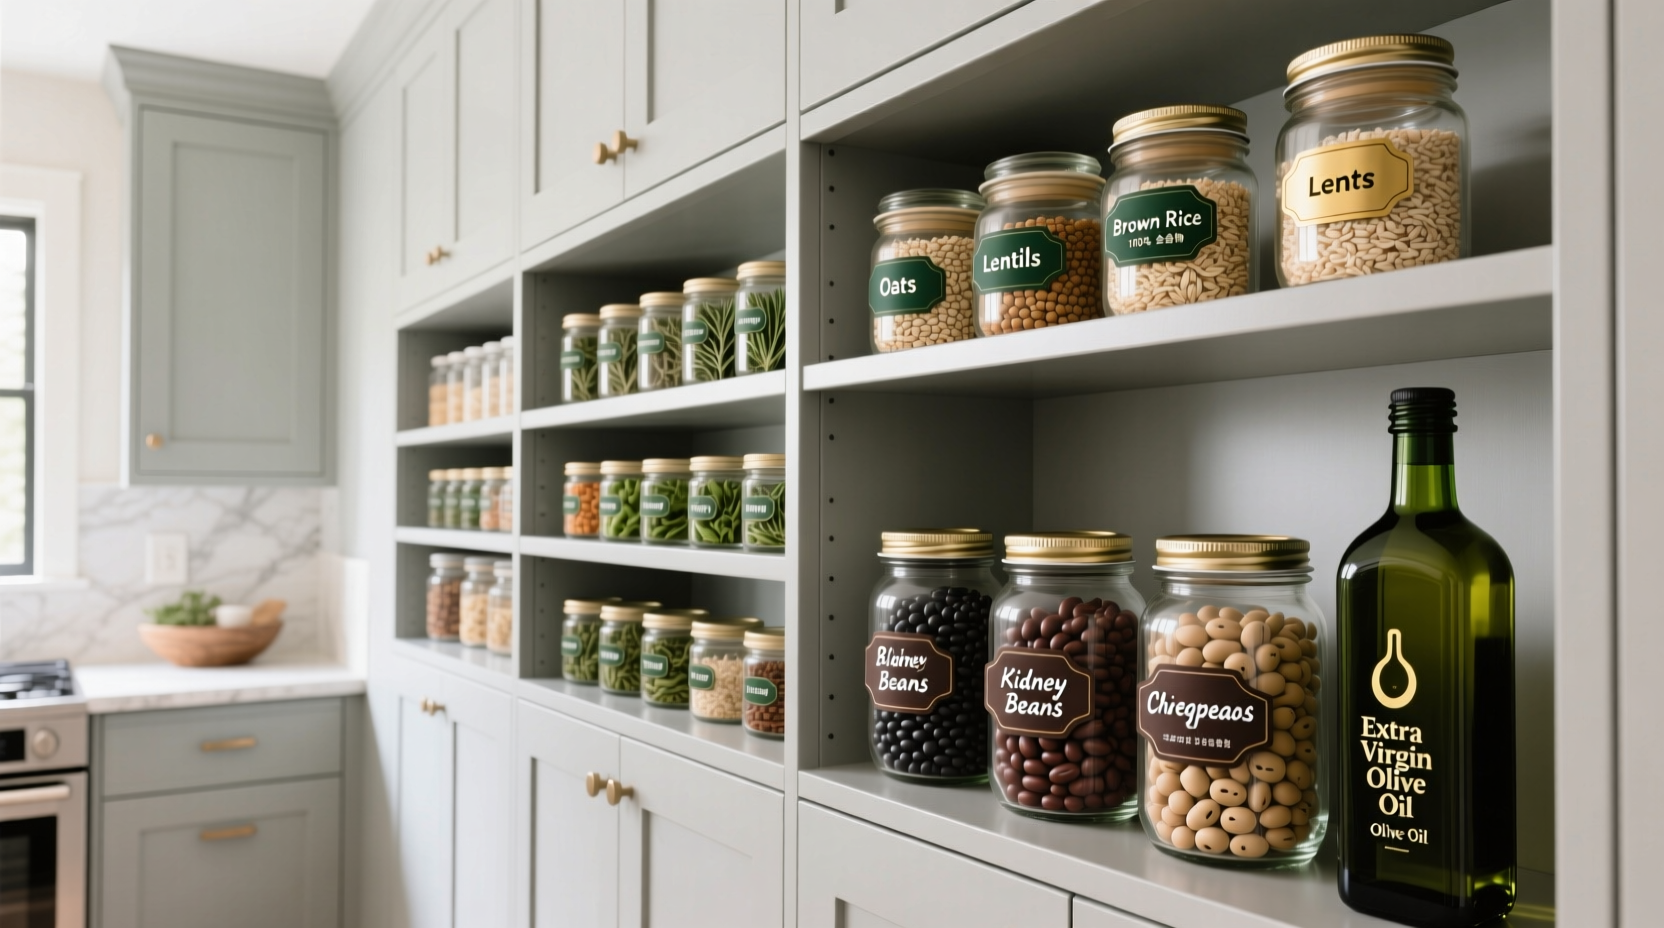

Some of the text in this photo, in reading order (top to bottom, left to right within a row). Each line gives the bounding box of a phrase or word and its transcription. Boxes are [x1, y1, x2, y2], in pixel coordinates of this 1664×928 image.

[1309, 169, 1375, 197] Lents
[1113, 209, 1202, 237] Brown Rice
[983, 246, 1041, 273] Lentils
[880, 277, 917, 297] Oats
[878, 670, 928, 693] Beans
[1000, 666, 1067, 701] Kidney
[1005, 692, 1063, 718] Beans
[1360, 715, 1423, 744] Extra
[1360, 740, 1433, 772] Virgin
[1366, 766, 1427, 795] Olive
[1378, 792, 1414, 819] Oil
[1407, 828, 1429, 845] Oil
